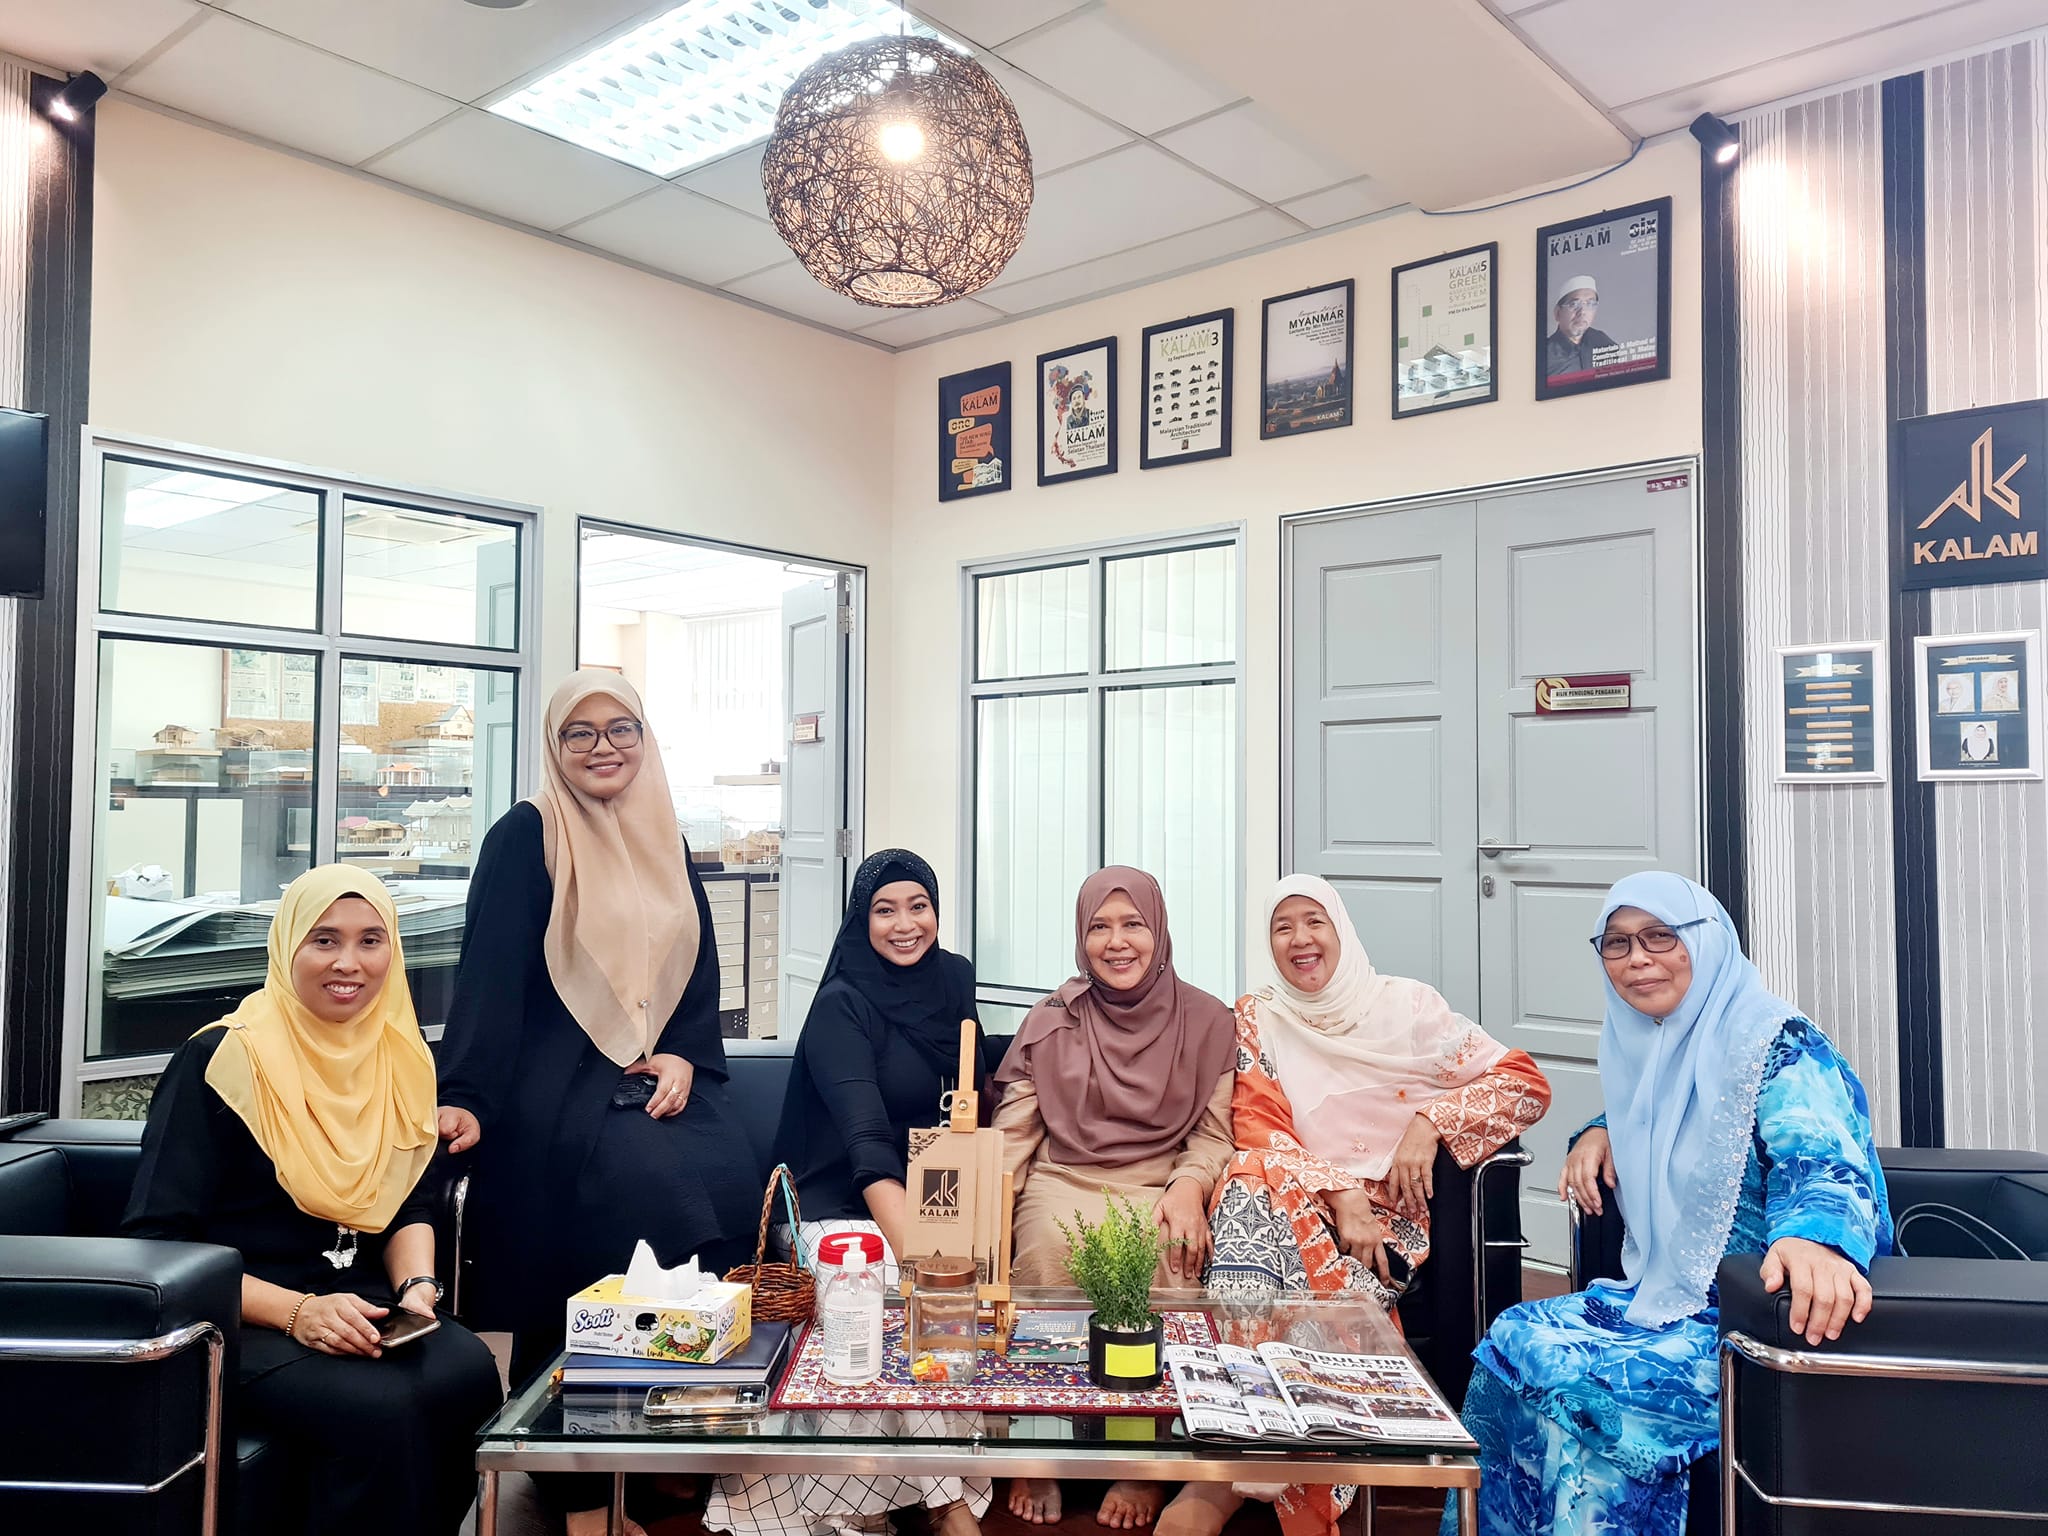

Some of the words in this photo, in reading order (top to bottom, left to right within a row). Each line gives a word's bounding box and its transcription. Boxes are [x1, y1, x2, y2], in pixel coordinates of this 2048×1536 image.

[1629, 217, 1657, 238] six
[1550, 230, 1611, 256] KALAM
[1449, 273, 1486, 289] GREEN
[1289, 309, 1344, 330] MYANMAR
[1173, 352, 1195, 360] September
[1592, 344, 1619, 354] Materials
[962, 395, 998, 412] KALAM
[1090, 409, 1105, 421] two
[951, 419, 971, 431] one
[1160, 426, 1184, 434] Malaysian
[1185, 420, 1213, 429] Traditional
[1067, 427, 1105, 444] KALAM
[1170, 428, 1201, 438] Architecture
[1913, 531, 2038, 564] KALAM
[920, 1209, 959, 1217] KALAM
[572, 1308, 614, 1333] Scott
[1318, 1355, 1406, 1365] BULETIN
